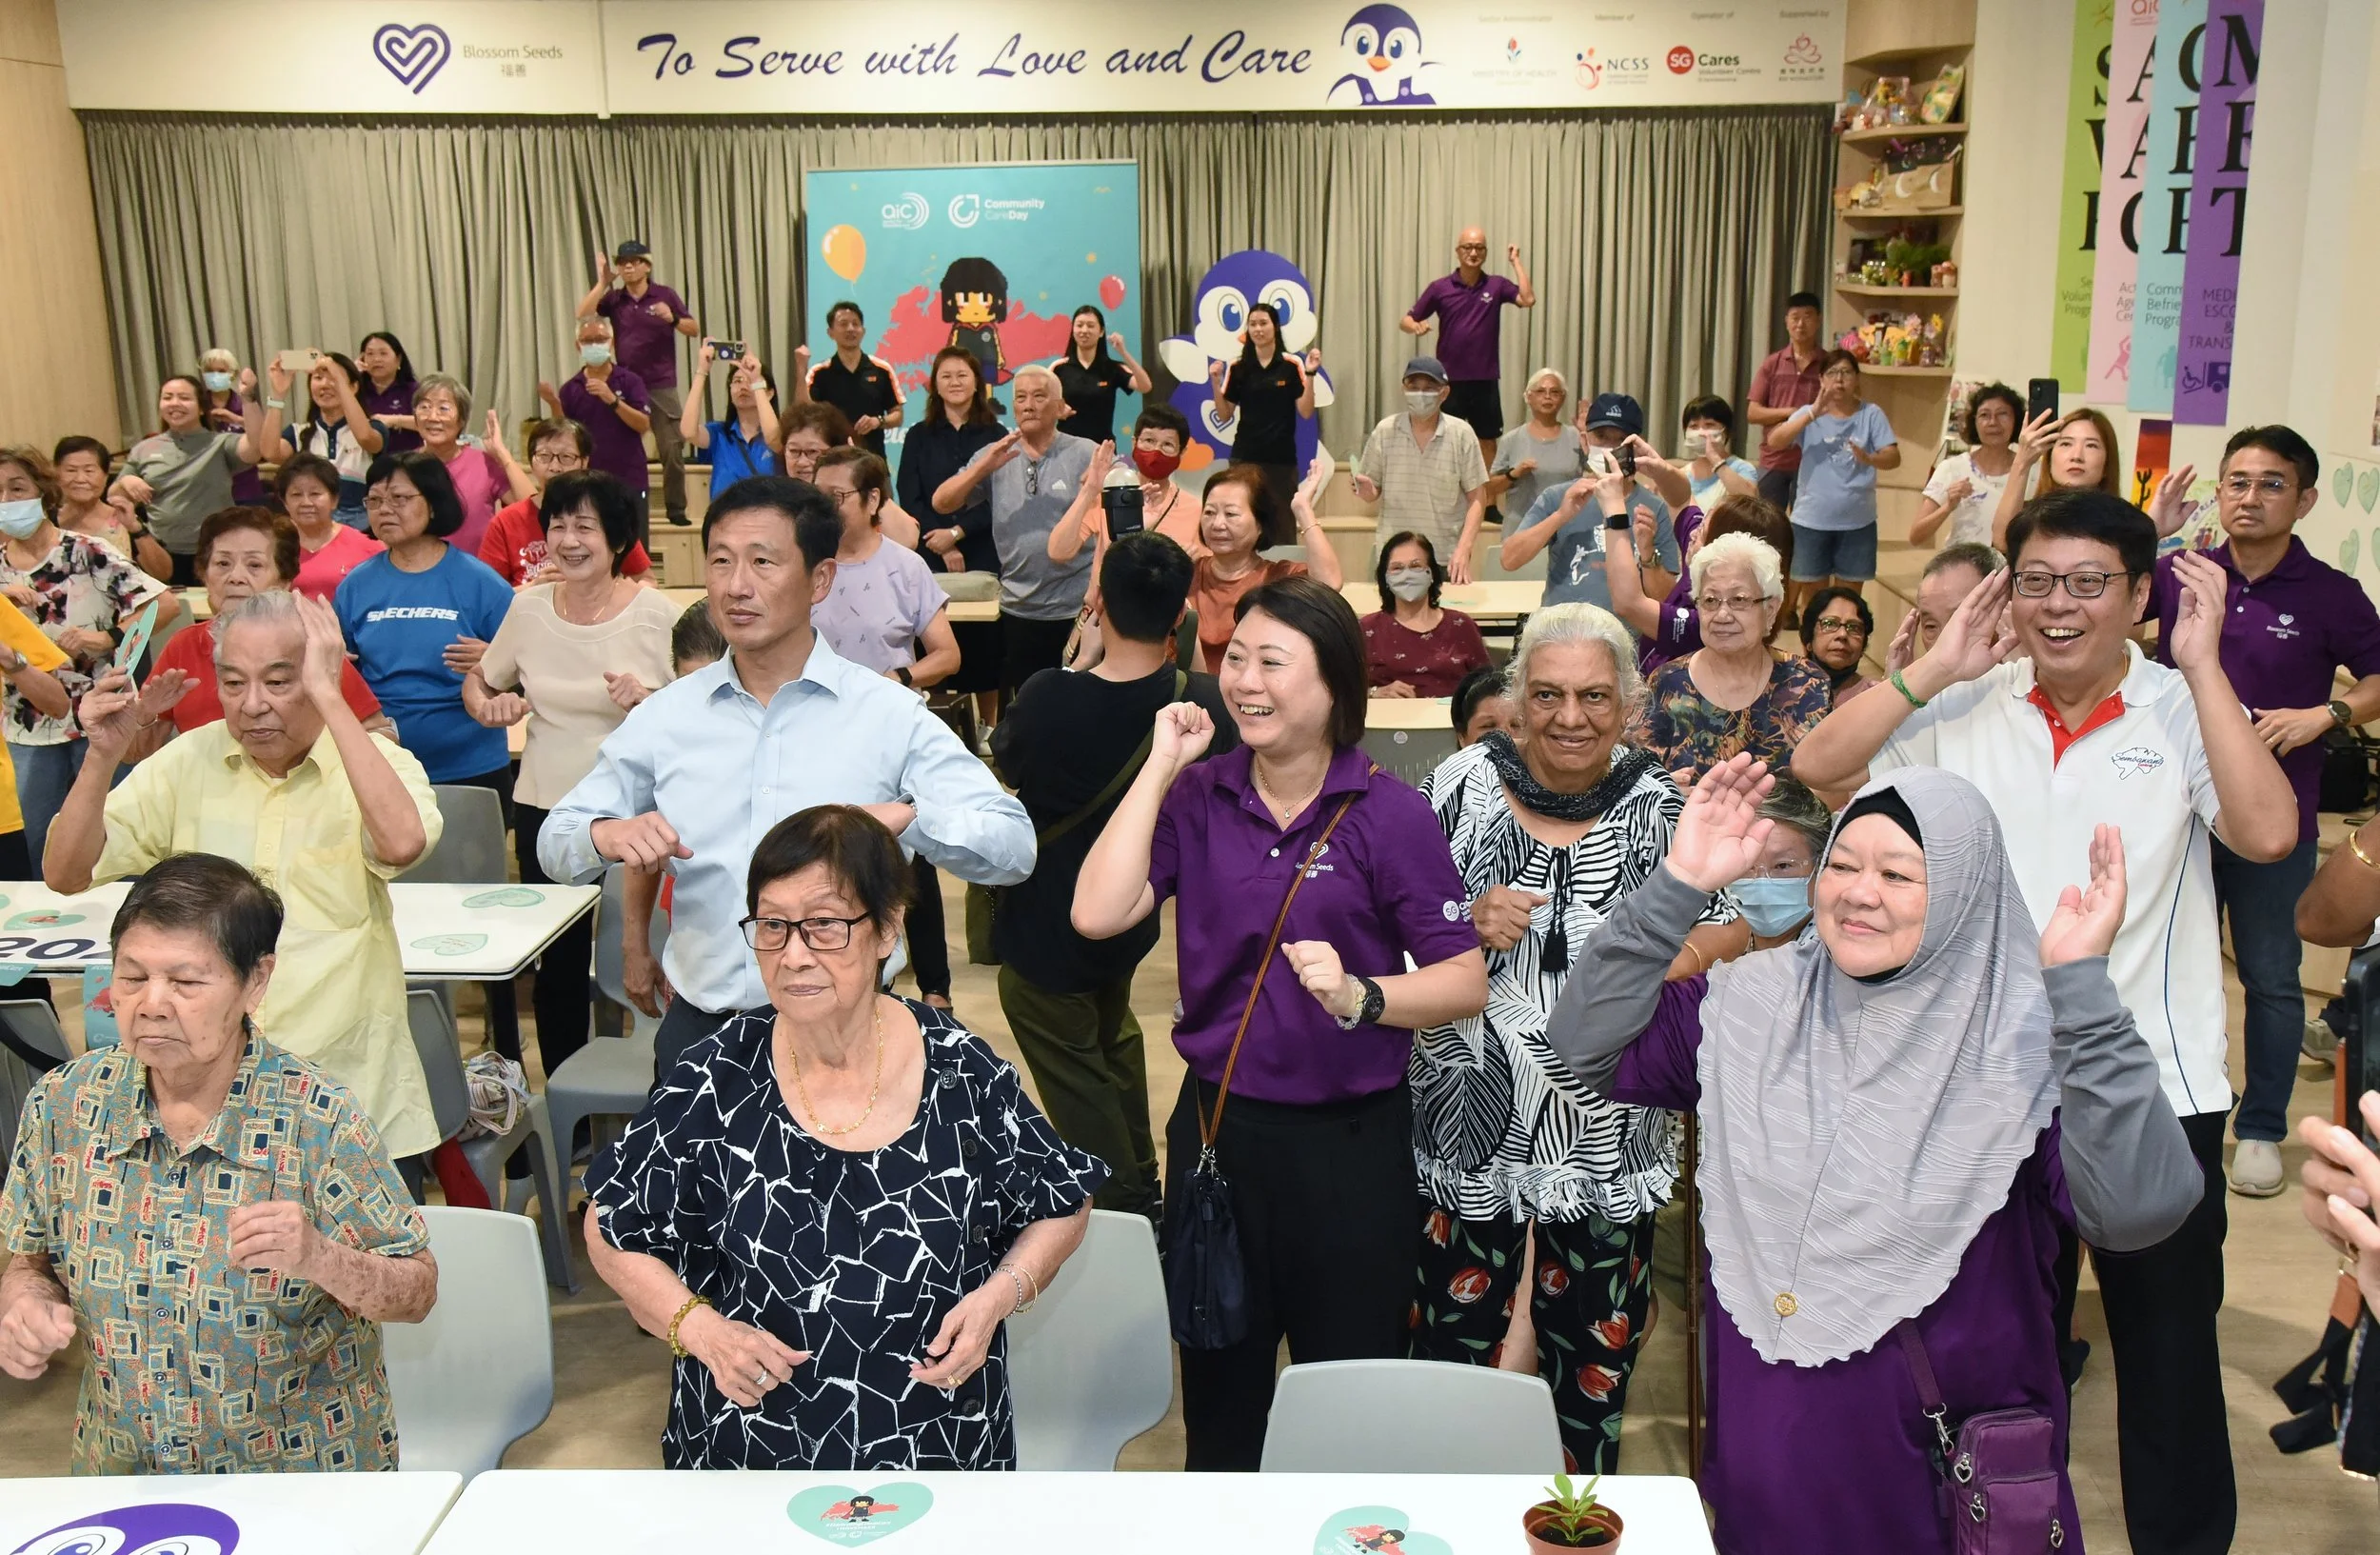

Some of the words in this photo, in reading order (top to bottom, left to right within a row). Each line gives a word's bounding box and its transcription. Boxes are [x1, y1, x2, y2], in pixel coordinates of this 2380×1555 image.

[463, 45, 520, 59] Blossom
[523, 45, 564, 59] Seeds
[637, 33, 696, 80] To
[715, 36, 844, 78] Serve
[864, 32, 960, 75] with
[977, 32, 1087, 77] Love
[1105, 34, 1193, 74] and
[1200, 30, 1313, 84] Care
[1607, 57, 1650, 71] NCSS
[1669, 52, 1692, 68] SG
[1697, 53, 1740, 67] Cares
[984, 198, 1045, 209] Community
